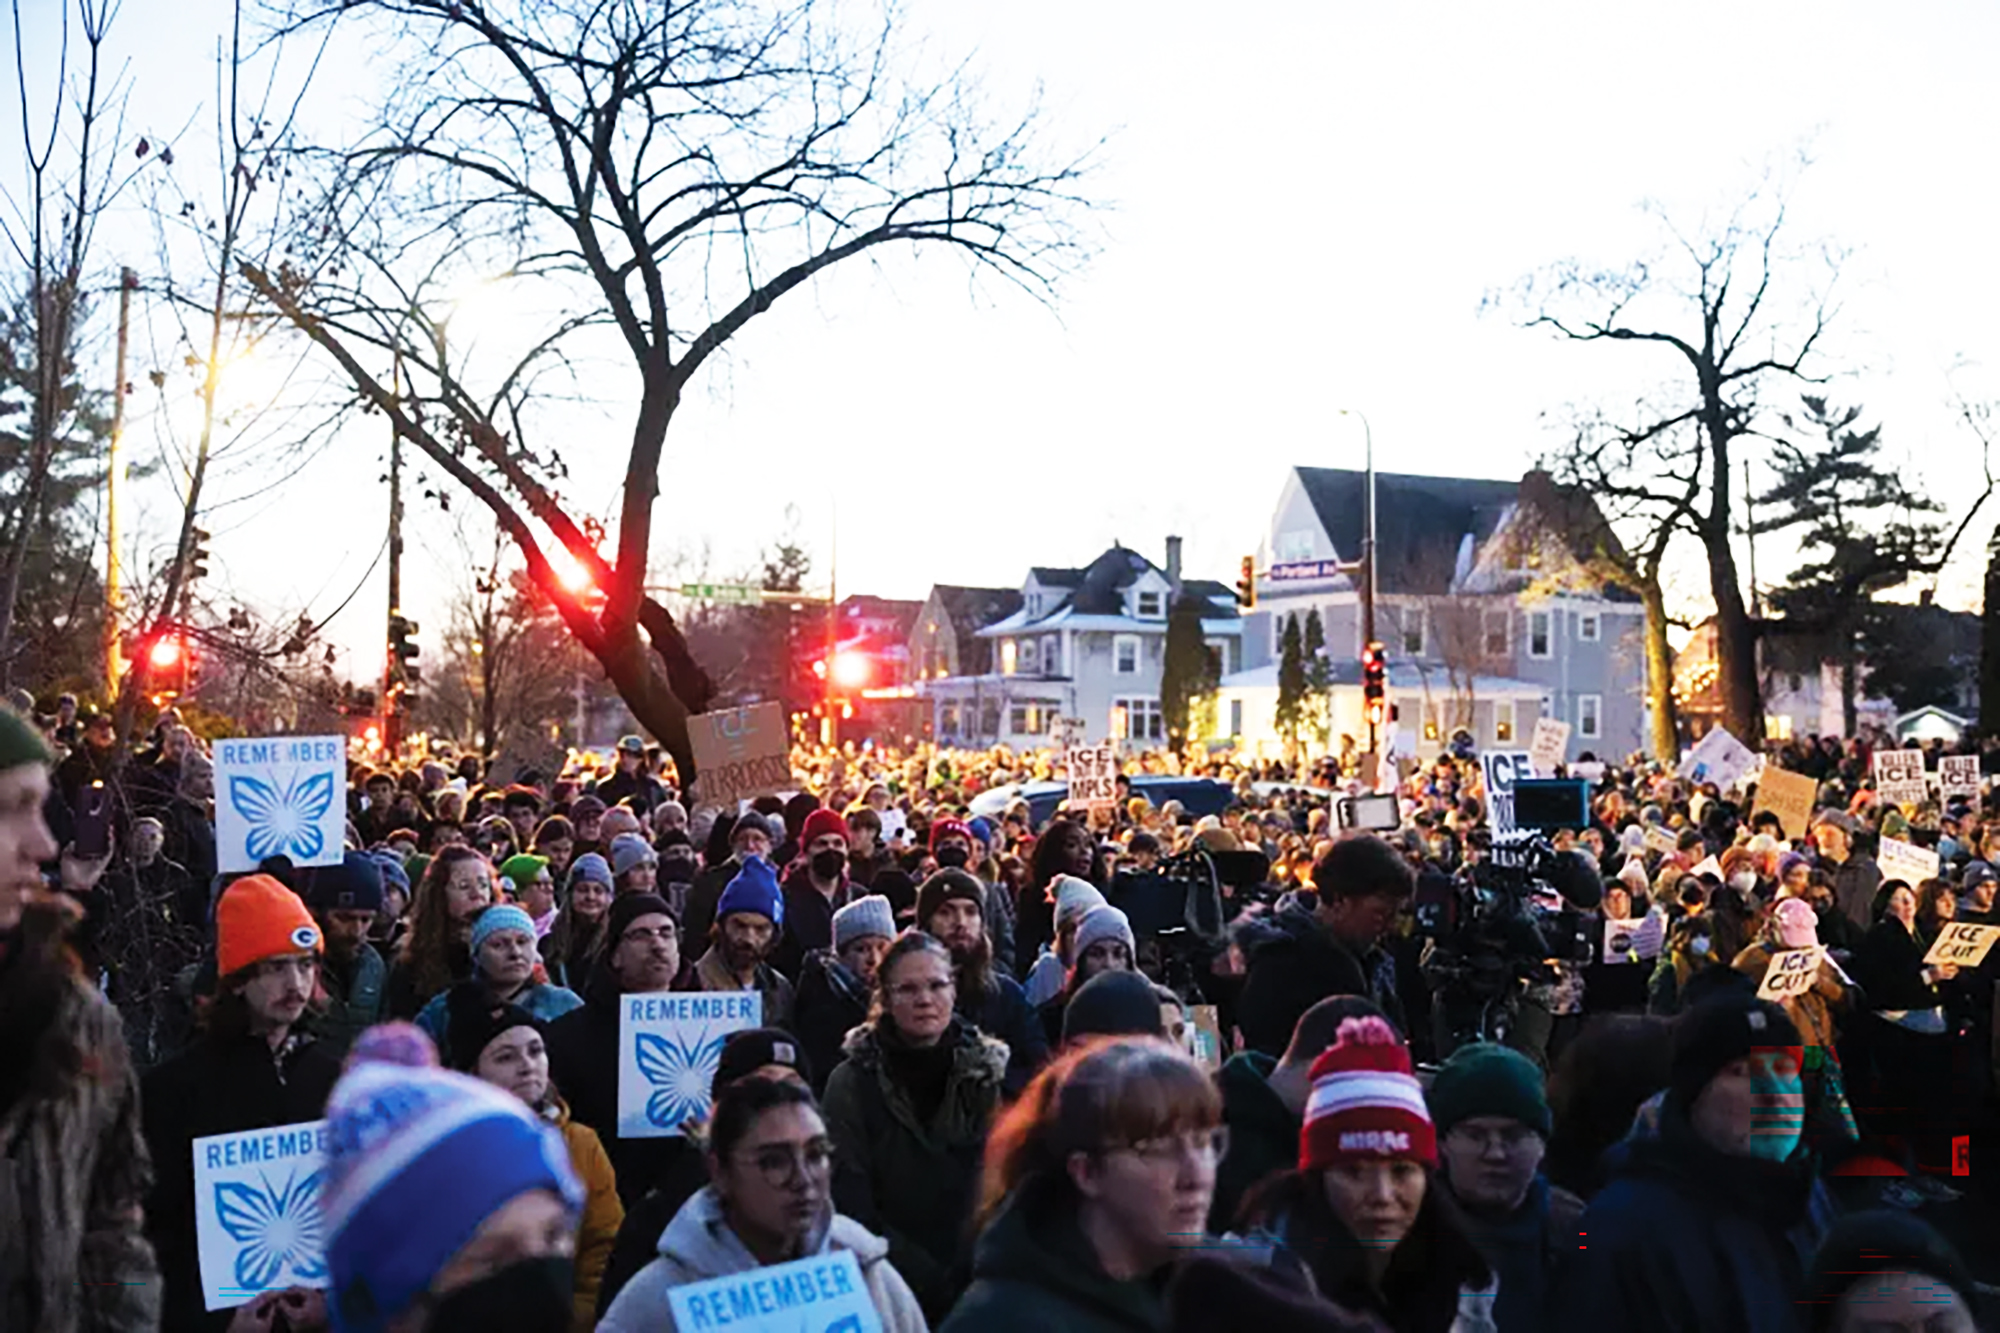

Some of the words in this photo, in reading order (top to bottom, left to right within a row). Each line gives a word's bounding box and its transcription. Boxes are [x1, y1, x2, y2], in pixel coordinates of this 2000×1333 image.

[1071, 749, 1110, 763] ICE
[1484, 754, 1531, 792] ICE
[1879, 766, 1923, 782] ICE
[1941, 770, 1977, 785] ICE
[1072, 778, 1113, 799] MPLS
[1949, 926, 1985, 941] ICE
[1936, 942, 1979, 959] OUT
[1780, 952, 1814, 971] ICE
[1768, 971, 1811, 991] OUT
[631, 997, 752, 1021] REMEMBER
[206, 1130, 329, 1169] REMEMBE
[687, 1264, 853, 1330] REMEMBER
